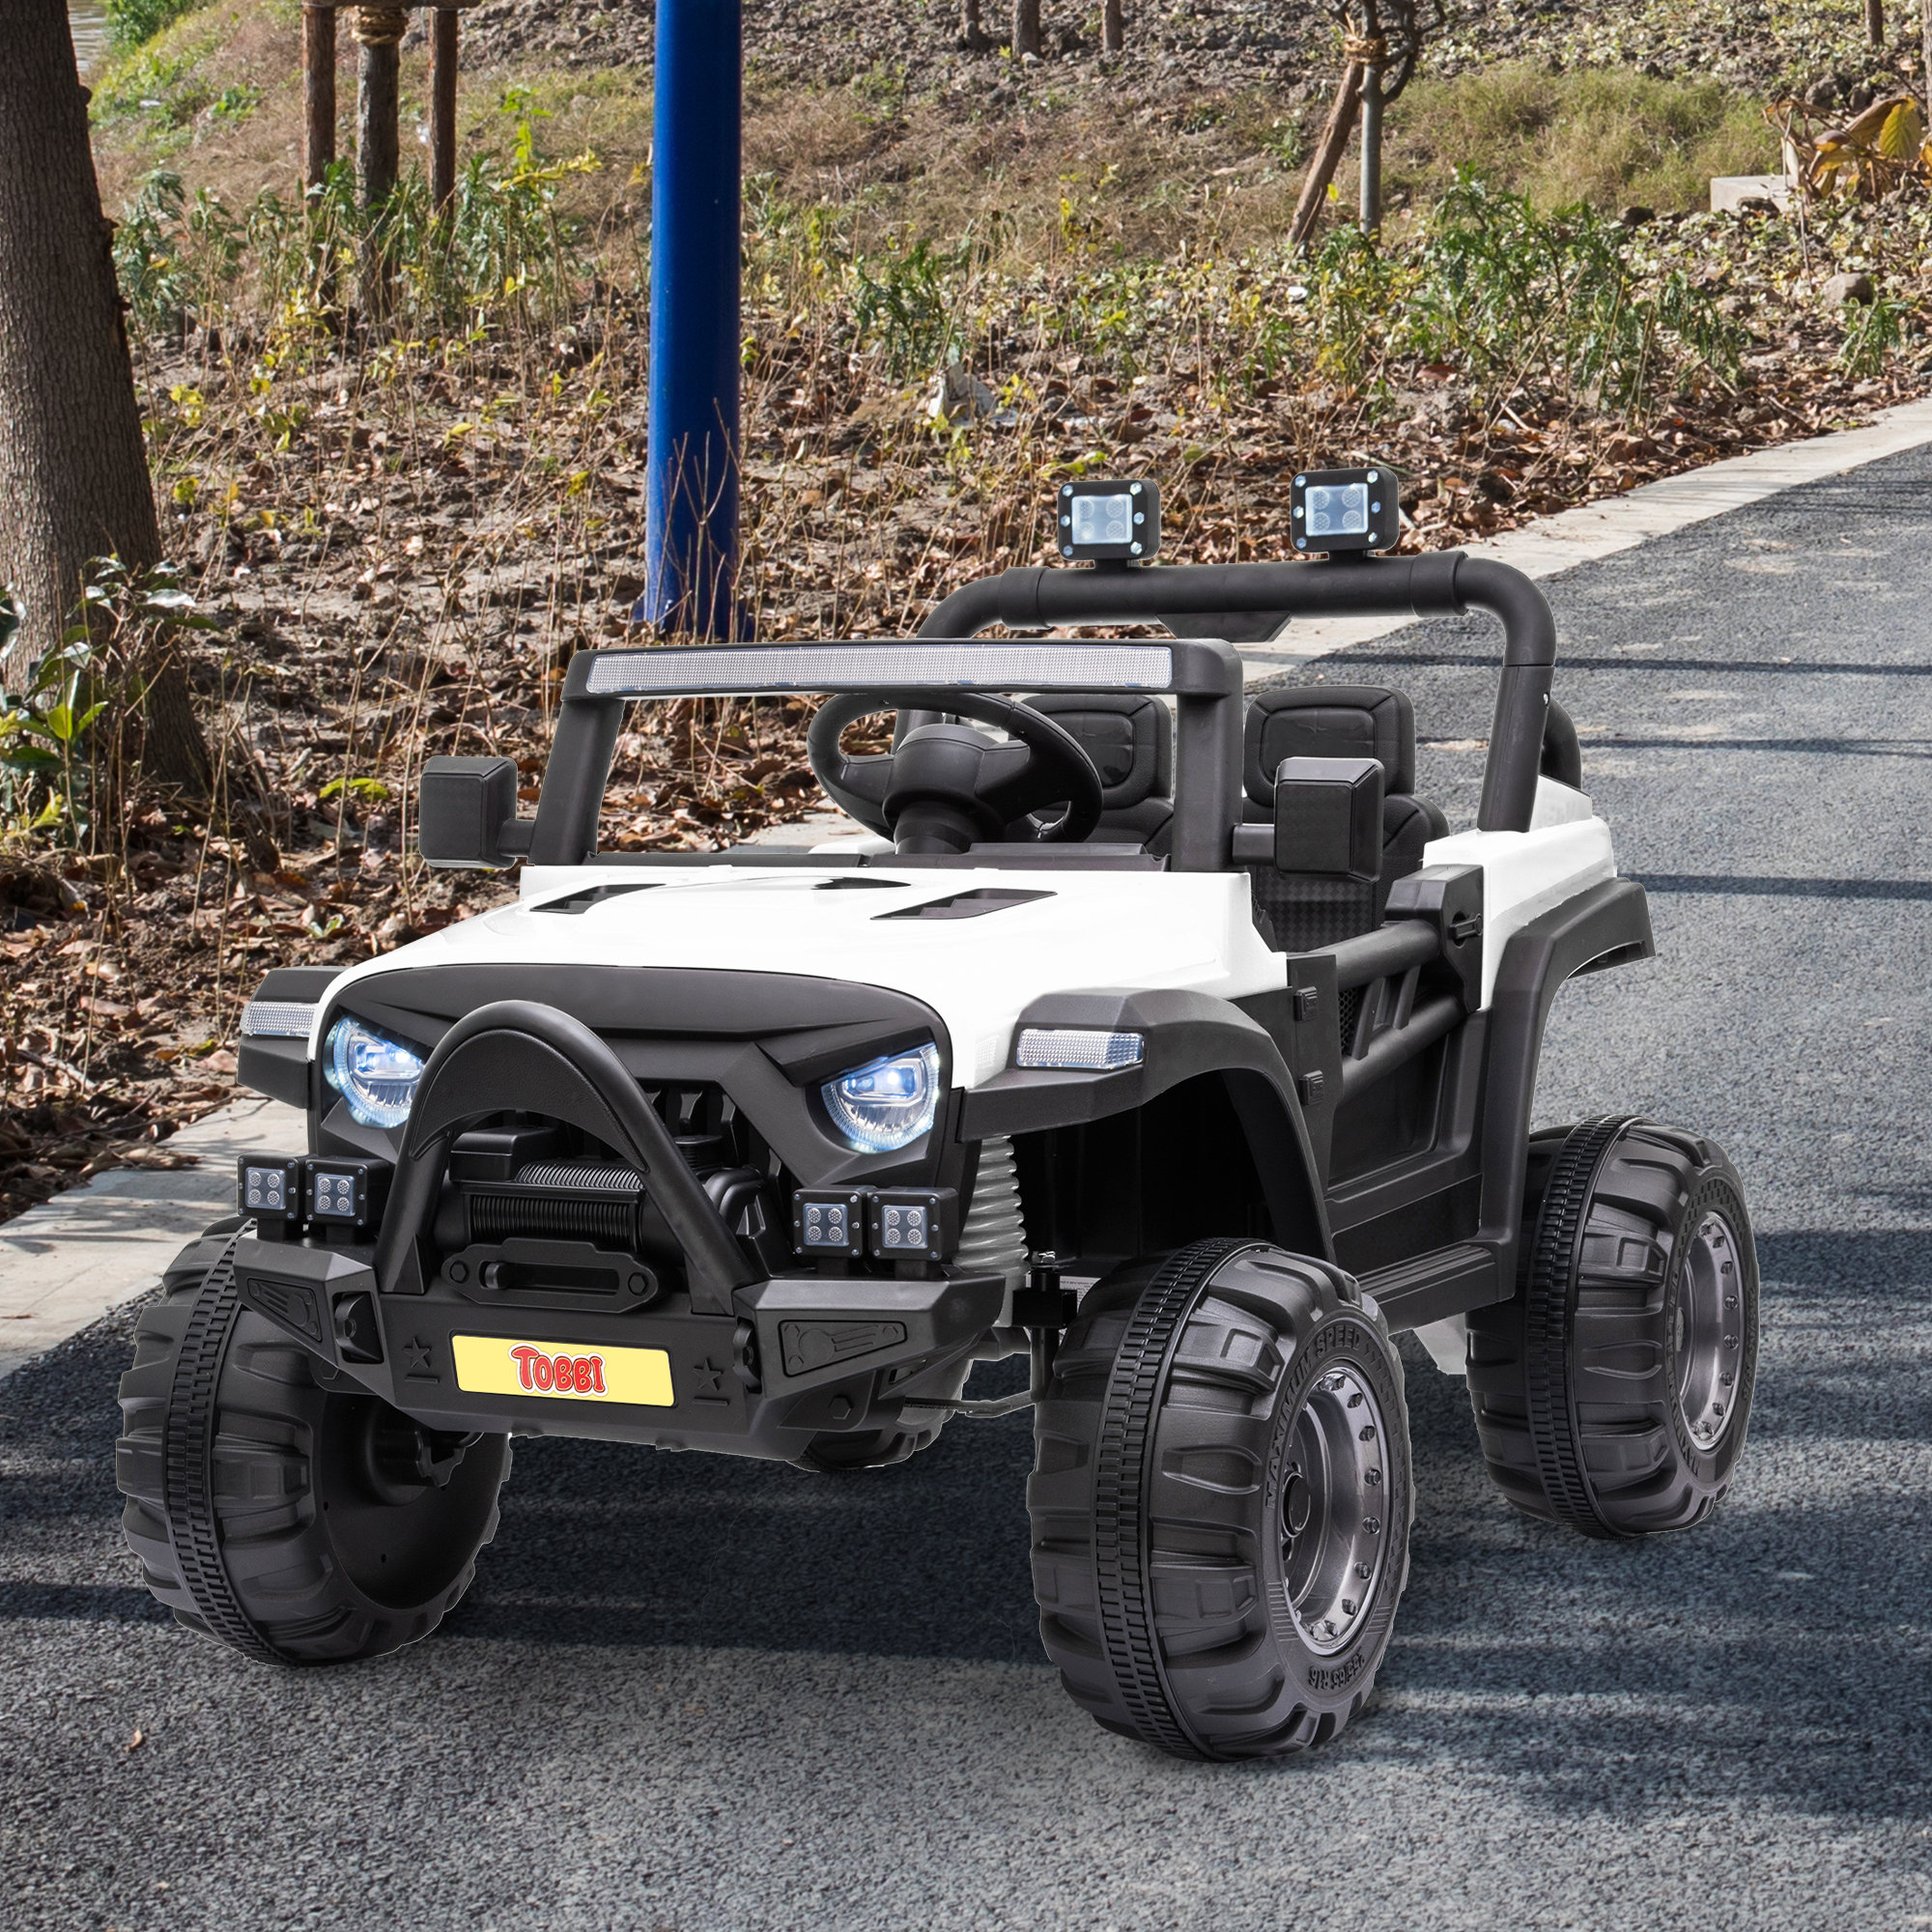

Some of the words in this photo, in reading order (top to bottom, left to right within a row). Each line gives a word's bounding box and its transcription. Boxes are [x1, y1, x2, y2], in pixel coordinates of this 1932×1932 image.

[510, 1345, 607, 1394] TOBBI
[1265, 1348, 1312, 1509] MAXIMUM
[1315, 1324, 1361, 1359] SPEED
